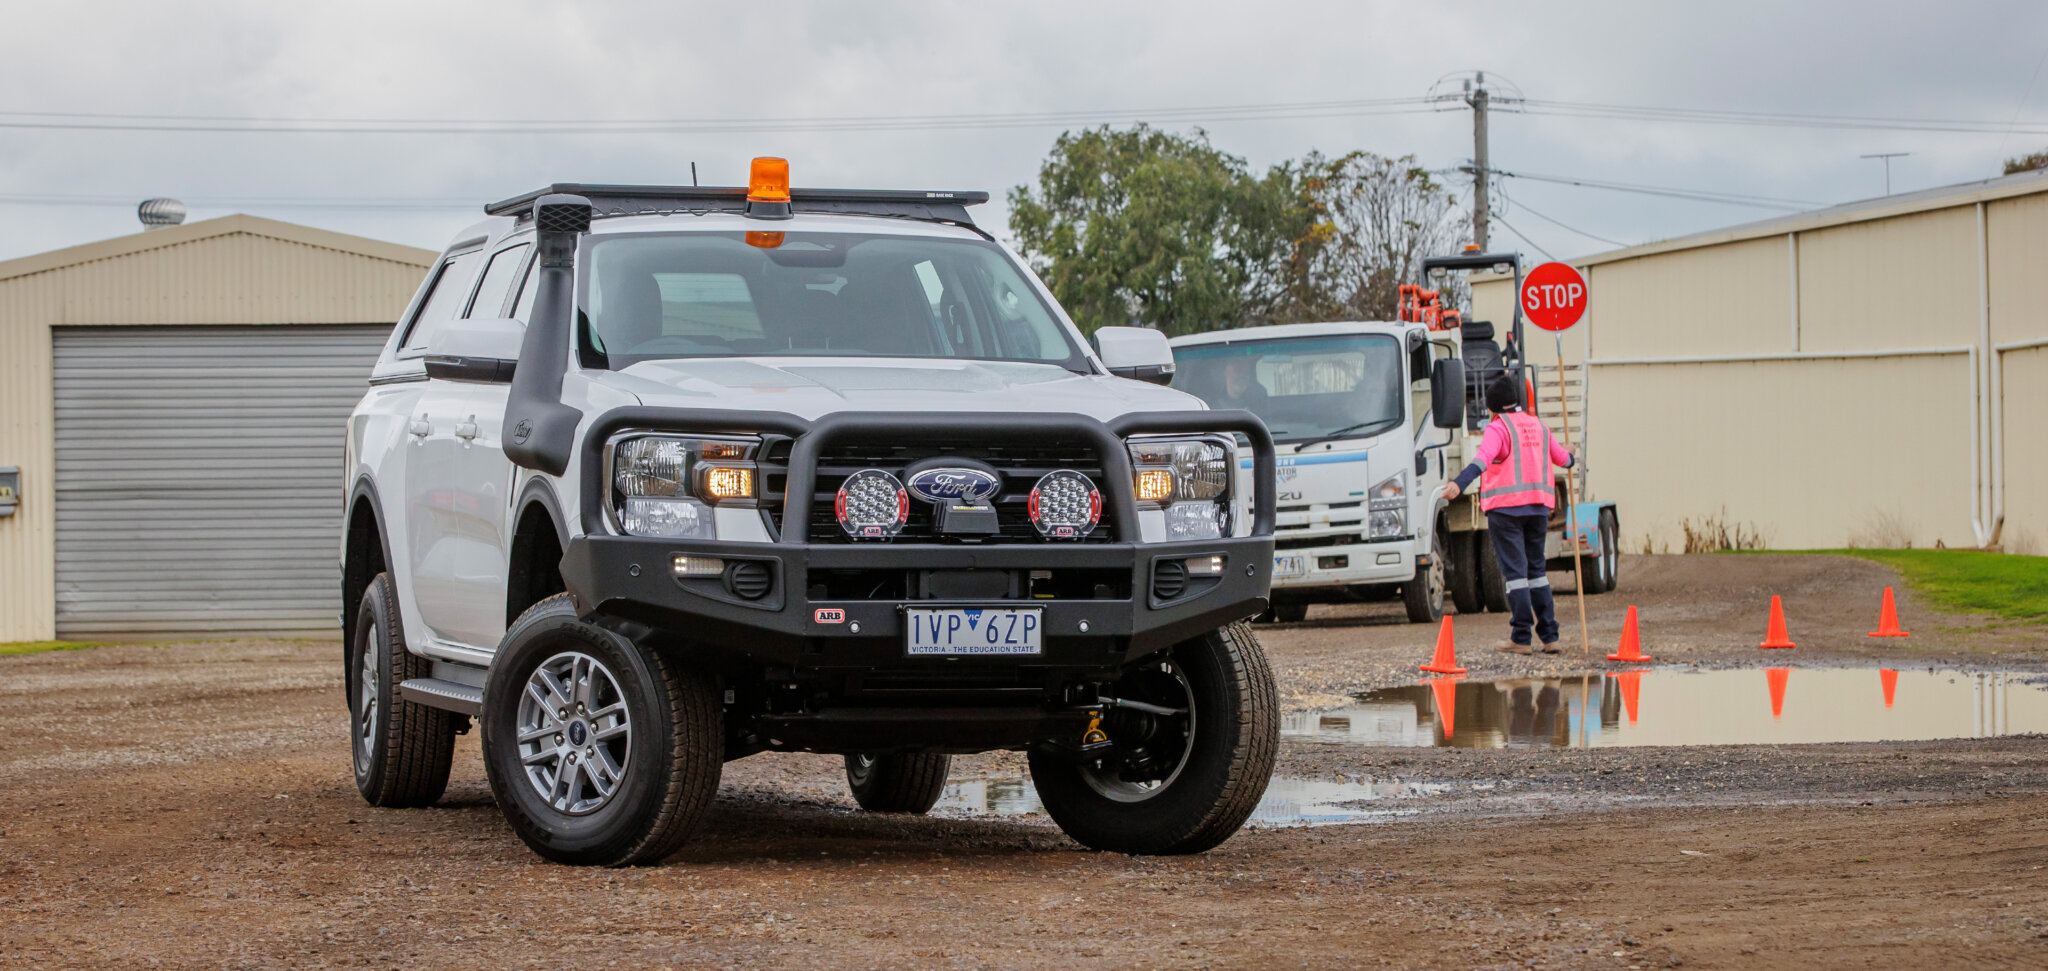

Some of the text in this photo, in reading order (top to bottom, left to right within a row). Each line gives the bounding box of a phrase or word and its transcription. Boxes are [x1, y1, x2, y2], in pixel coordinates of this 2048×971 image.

[1527, 283, 1583, 310] STOP
[930, 473, 978, 495] Ford
[819, 611, 842, 620] ARB
[913, 614, 1037, 644] 1VP 6ZP
